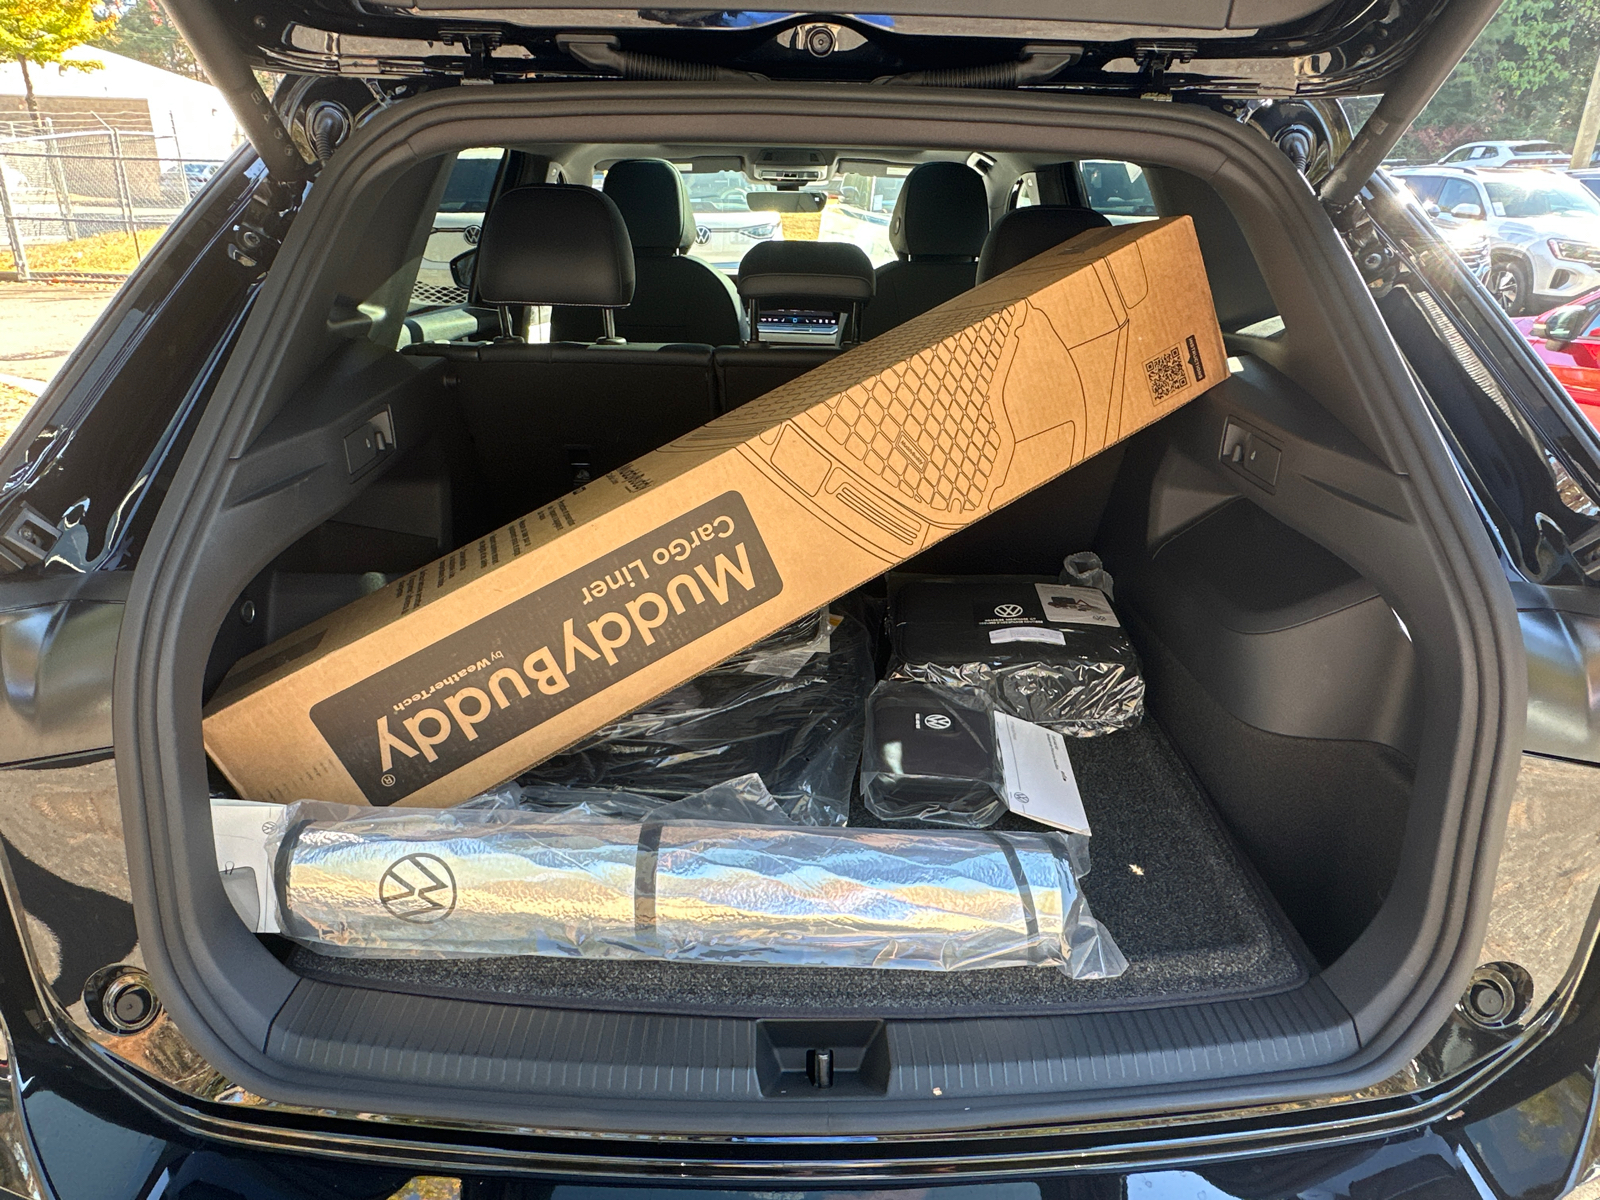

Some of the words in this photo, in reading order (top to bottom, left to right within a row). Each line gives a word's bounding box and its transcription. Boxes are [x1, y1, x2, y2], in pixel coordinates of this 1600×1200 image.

[1189, 337, 1203, 379] INSTRUCTIONS
[652, 515, 735, 565] CarGo
[581, 558, 650, 605] Liner
[490, 650, 504, 662] by
[392, 657, 491, 711] WeatherTech
